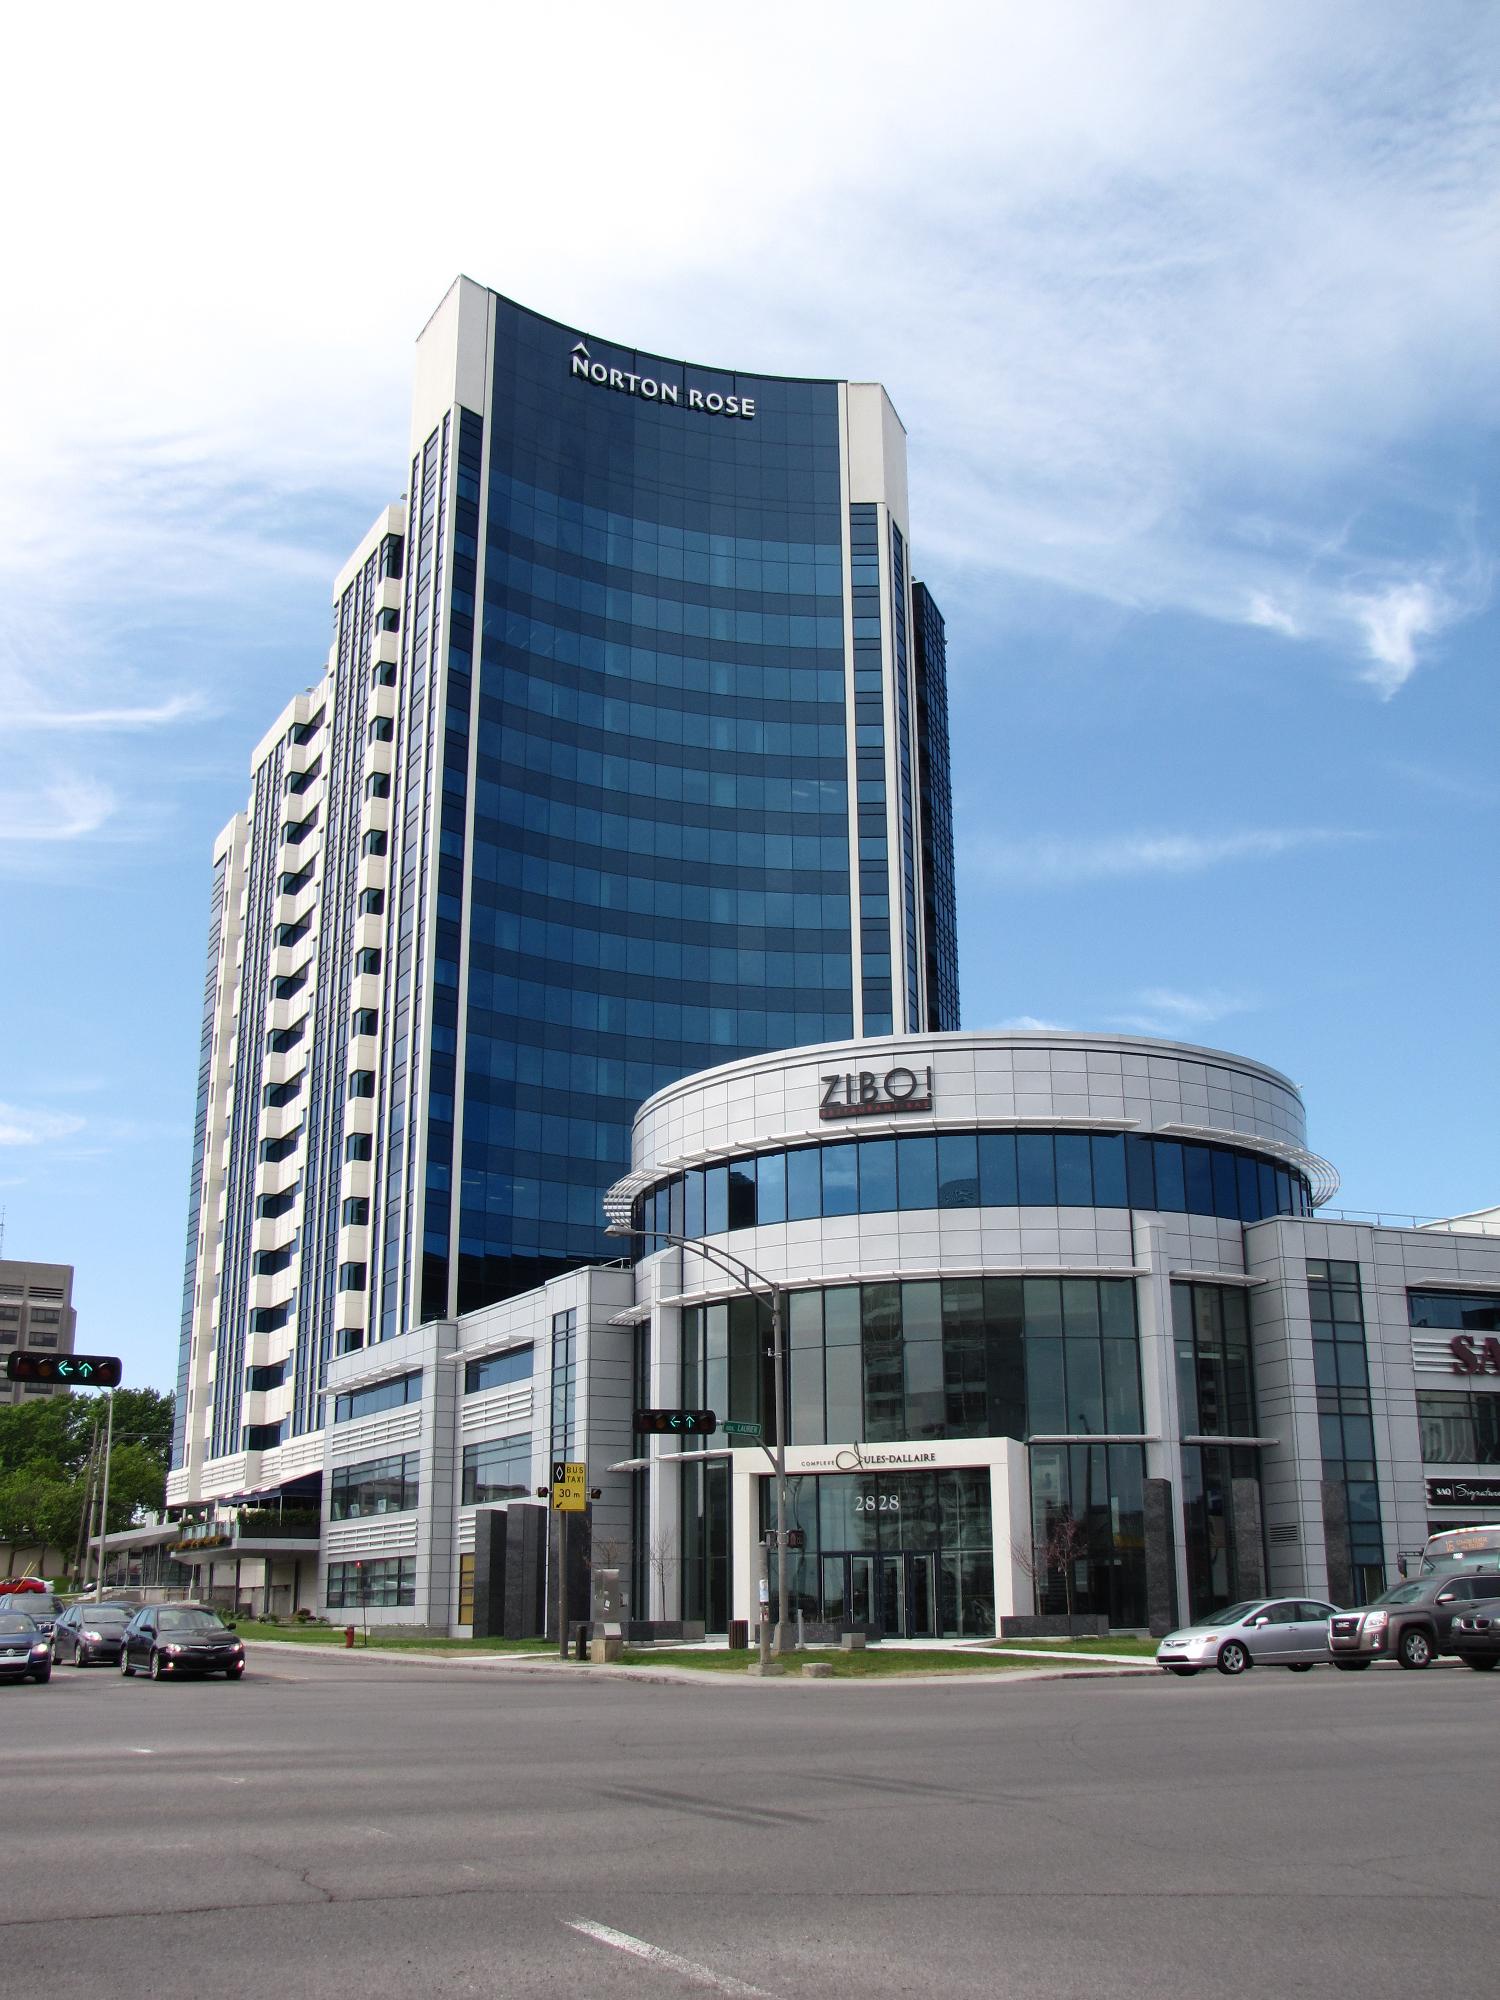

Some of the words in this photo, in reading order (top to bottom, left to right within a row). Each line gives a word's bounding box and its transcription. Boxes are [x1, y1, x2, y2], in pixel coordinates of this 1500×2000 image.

[572, 354, 678, 403] NORTON
[689, 388, 756, 417] ROSE
[821, 1066, 932, 1107] ZIBO!
[559, 1488, 571, 1498] 30
[855, 1494, 900, 1512] 2828
